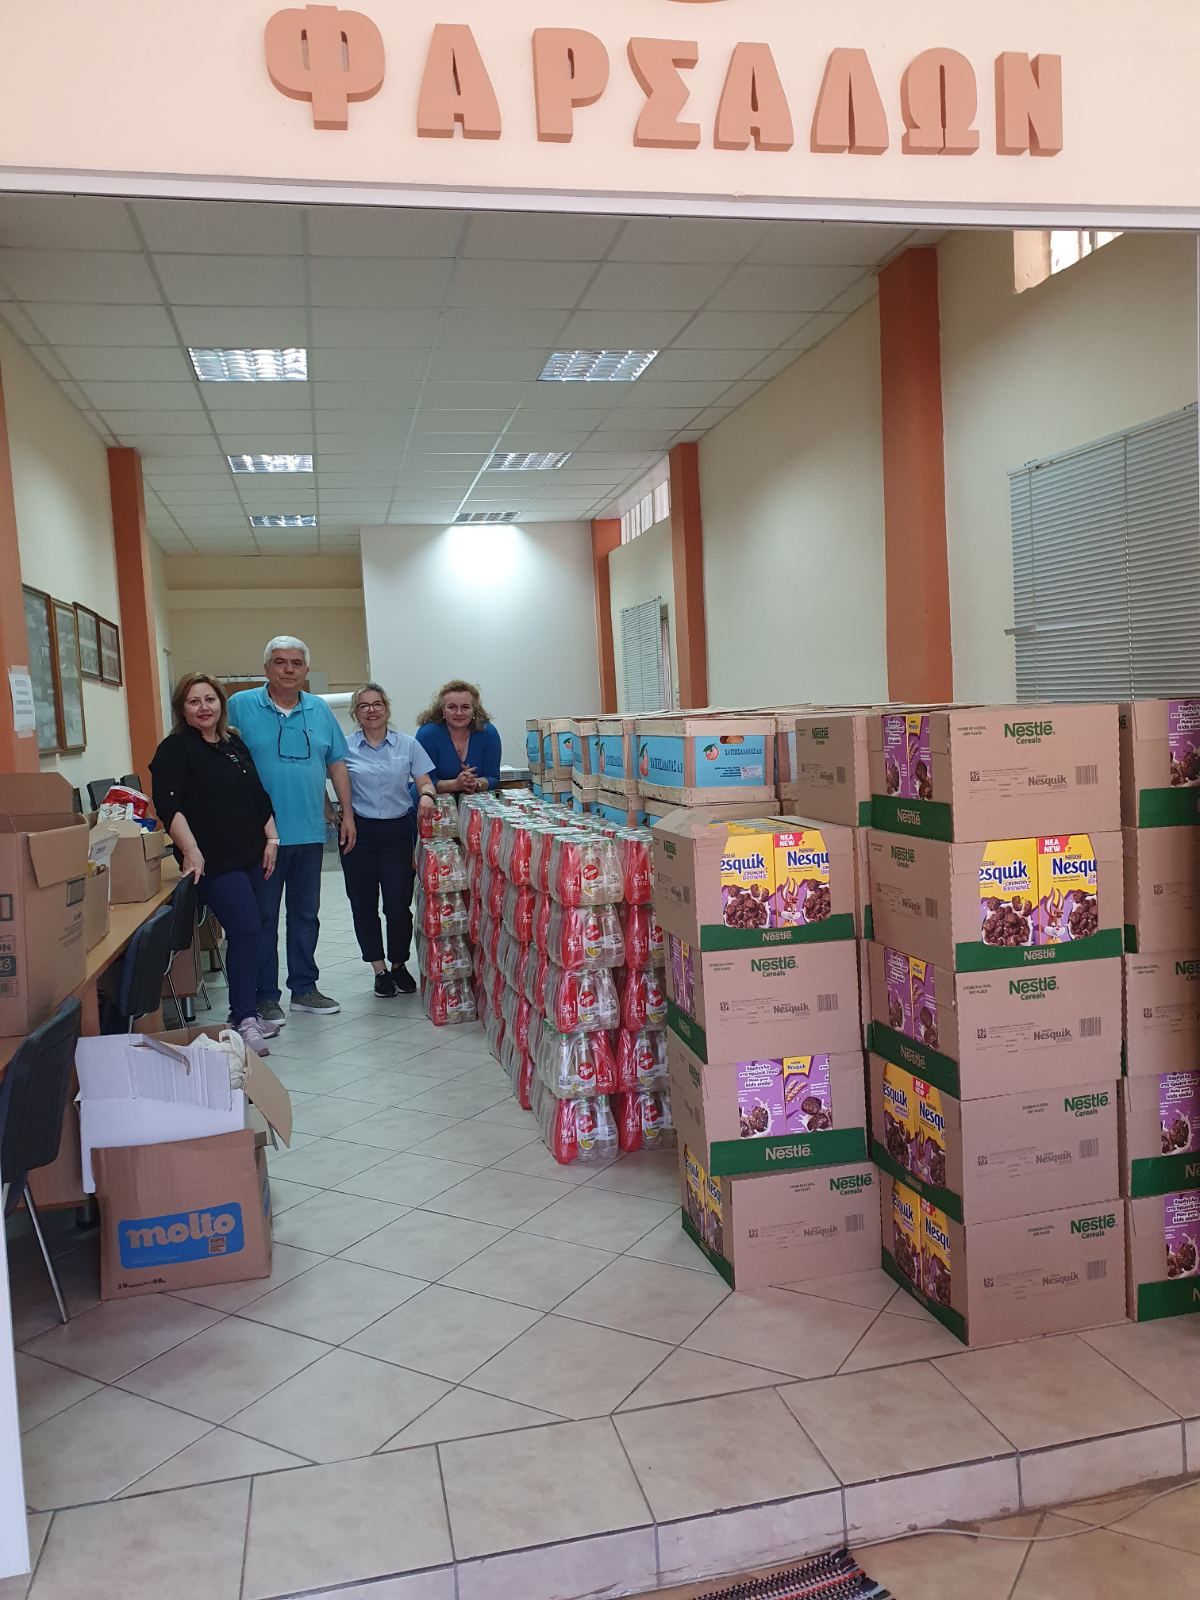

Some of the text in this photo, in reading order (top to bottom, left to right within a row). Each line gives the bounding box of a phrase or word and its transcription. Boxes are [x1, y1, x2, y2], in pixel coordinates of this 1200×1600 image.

[264, 4, 1063, 157] ΦΑΡΣΑΛΩΝ
[1016, 737, 1042, 745] Cereals
[1028, 774, 1067, 786] Nesquik
[762, 970, 786, 978] Cereals
[1020, 992, 1046, 1000] Cereals
[773, 1002, 810, 1017] Nesquik
[1033, 1028, 1072, 1042] Nesquik
[1074, 1108, 1098, 1118] Cereals
[1036, 1150, 1072, 1165] Nesquik
[840, 1187, 863, 1196] Cereals
[127, 1213, 235, 1248] molto
[1081, 1229, 1105, 1239] Cereals
[1042, 1272, 1080, 1286] Nesquik
